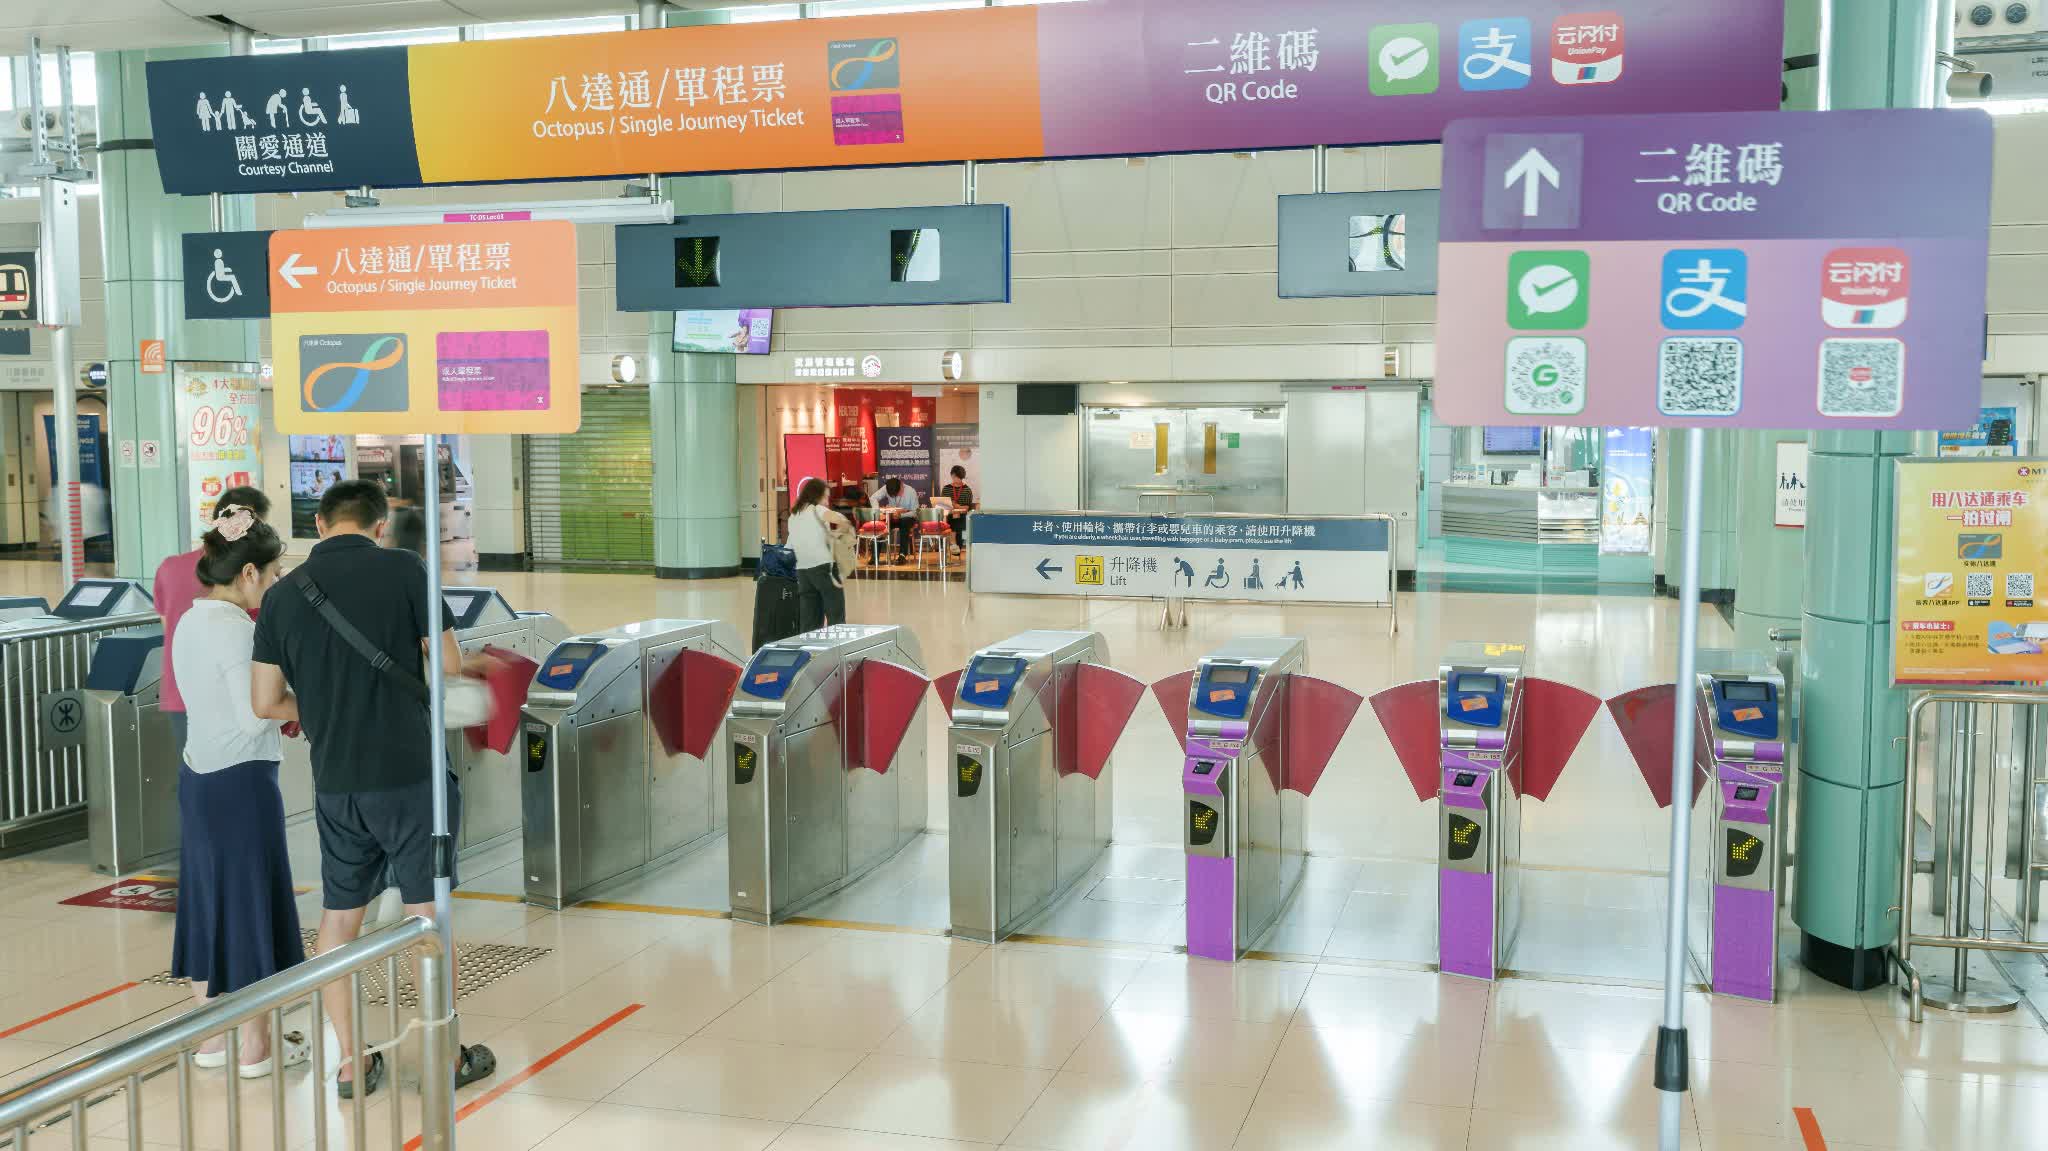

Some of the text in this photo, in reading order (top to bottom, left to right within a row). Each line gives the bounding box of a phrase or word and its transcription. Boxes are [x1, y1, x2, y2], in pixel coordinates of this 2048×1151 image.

[1556, 24, 1620, 45] 云闪付
[1184, 27, 1320, 76] 二維碼
[1567, 46, 1608, 57] UnionPay
[545, 62, 786, 114] 八達通/單程票
[1206, 81, 1298, 105] QR Code
[532, 106, 805, 140] Octopus / Single Journey Ticket
[234, 132, 329, 161] 關愛通道
[239, 160, 334, 177] Courtesy Channel
[1634, 142, 1785, 187] 二維碼
[1657, 191, 1758, 215] QR Code
[331, 241, 513, 276] 八達通/單程票
[1828, 262, 1904, 284] 云闪付
[326, 276, 517, 295] Octopus / Single Journey Ticket
[190, 405, 249, 447] 96%
[888, 435, 922, 447] CIES
[1931, 491, 2028, 507] 用八达通乘车
[1946, 510, 2013, 527] 一拍过闸
[1110, 556, 1158, 573] 升降機
[1110, 576, 1127, 586] Lift
